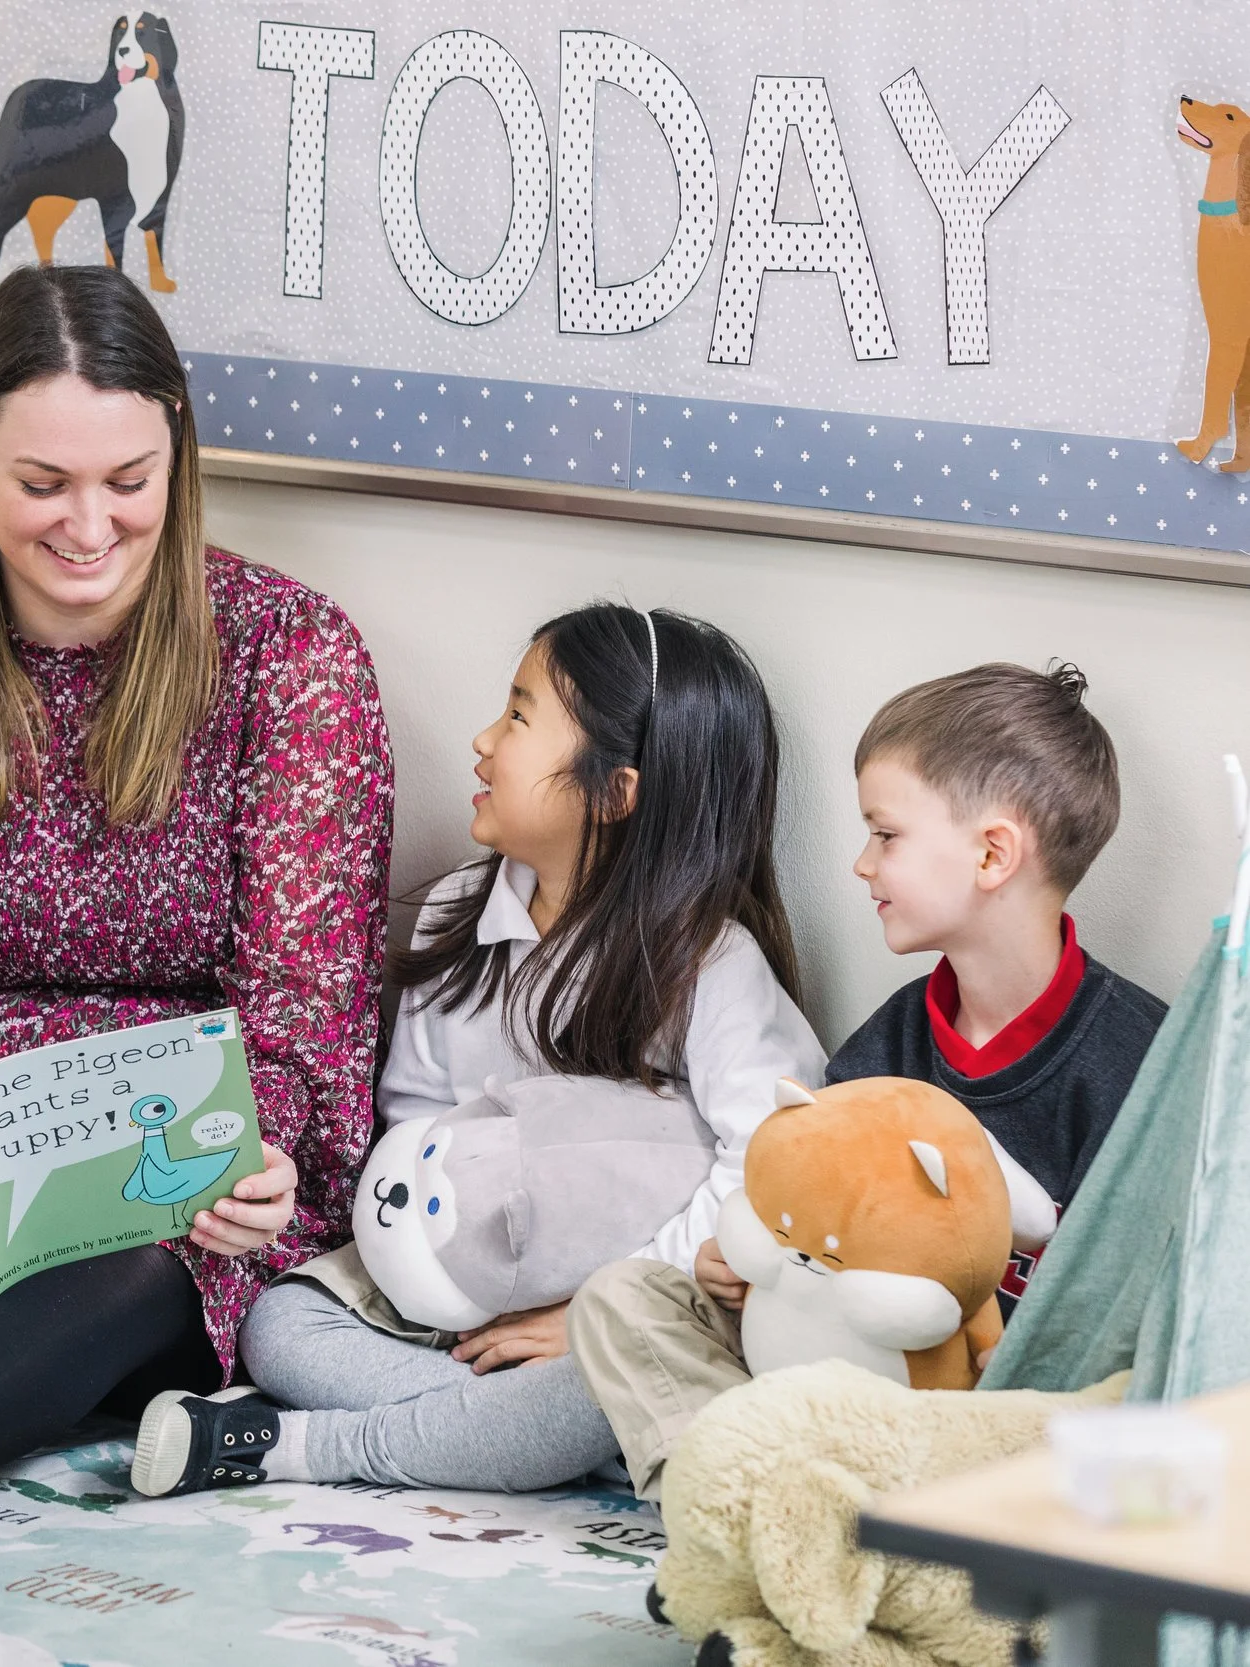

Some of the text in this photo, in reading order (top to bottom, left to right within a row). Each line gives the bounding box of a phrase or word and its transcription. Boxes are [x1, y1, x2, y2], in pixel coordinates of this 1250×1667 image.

[256, 19, 1073, 366] TODAY
[51, 1036, 194, 1082] Pigeon
[112, 1079, 135, 1096] a
[201, 1122, 235, 1134] really
[210, 1131, 228, 1140] do!
[23, 1255, 40, 1269] and
[43, 1243, 81, 1263] pictures
[83, 1240, 95, 1250] by
[98, 1236, 112, 1246] mo
[5, 1576, 141, 1614] OCEAN
[35, 1562, 195, 1605] INDIAN
